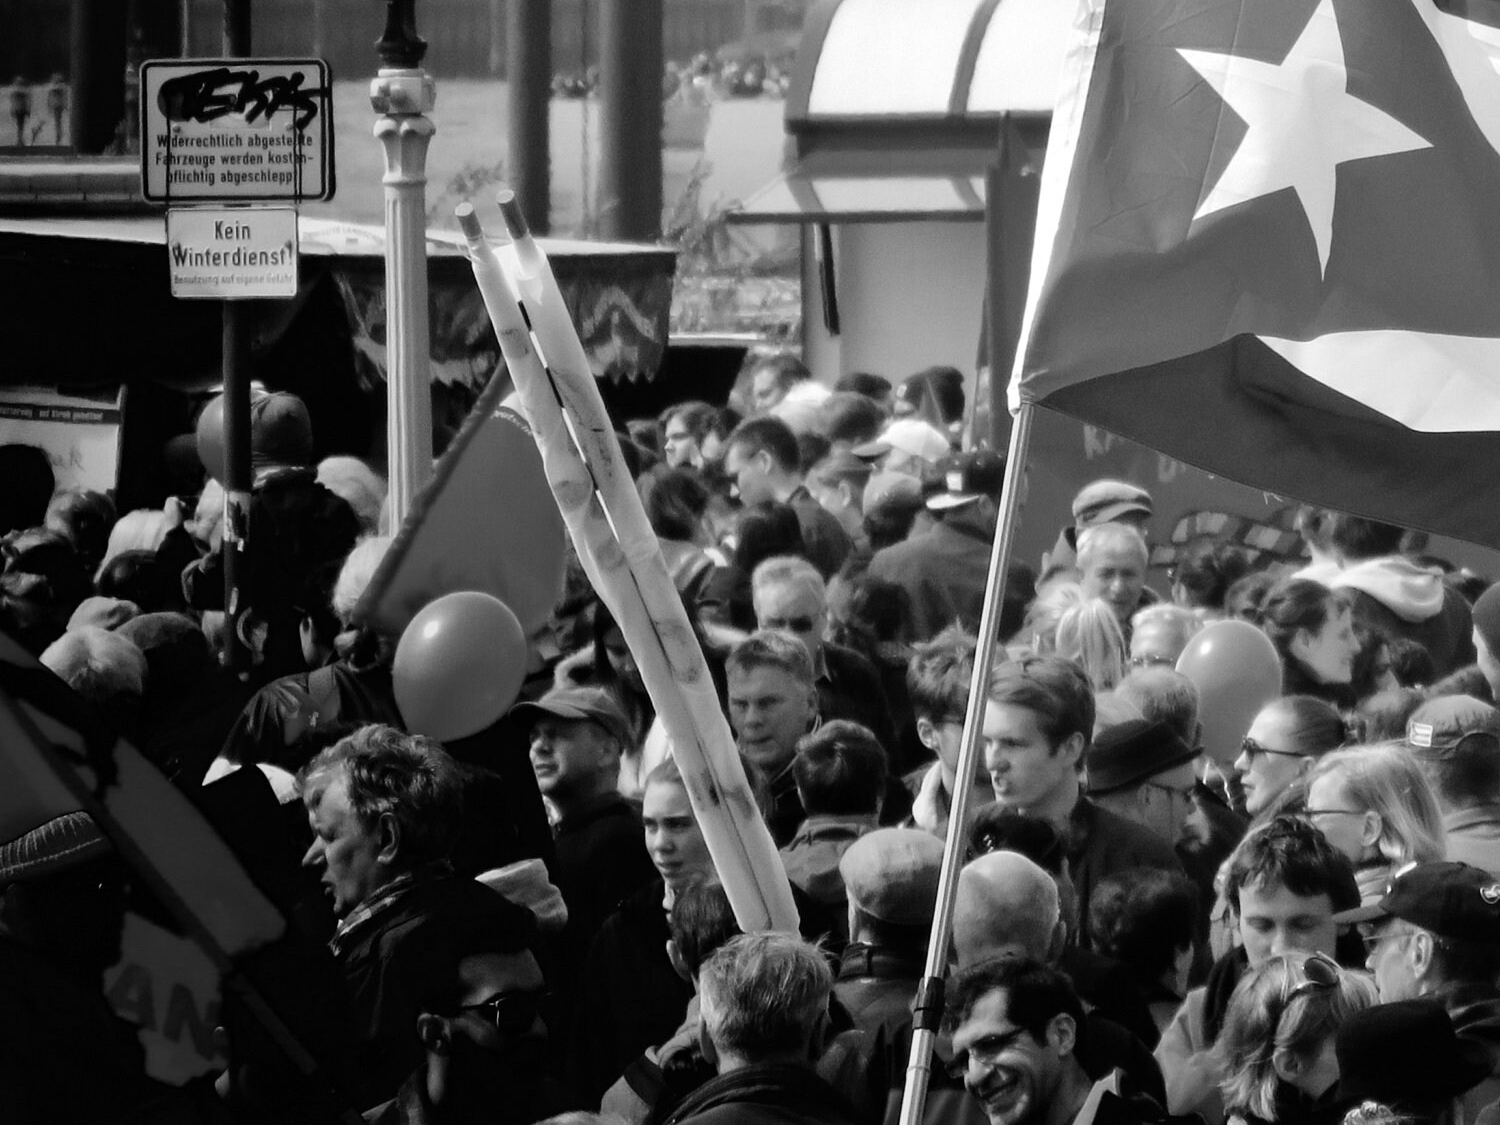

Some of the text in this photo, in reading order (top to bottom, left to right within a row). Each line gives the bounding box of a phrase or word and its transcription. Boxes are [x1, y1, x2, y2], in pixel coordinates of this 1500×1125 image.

[156, 133, 243, 148] Wderrechtlich
[220, 151, 263, 165] werden
[220, 169, 295, 187] abgeschlepp
[214, 220, 251, 240] Kein
[172, 241, 293, 267] Winterdienst!
[173, 274, 219, 286] Benutzung
[220, 274, 235, 284] auf
[236, 274, 264, 286] eigene
